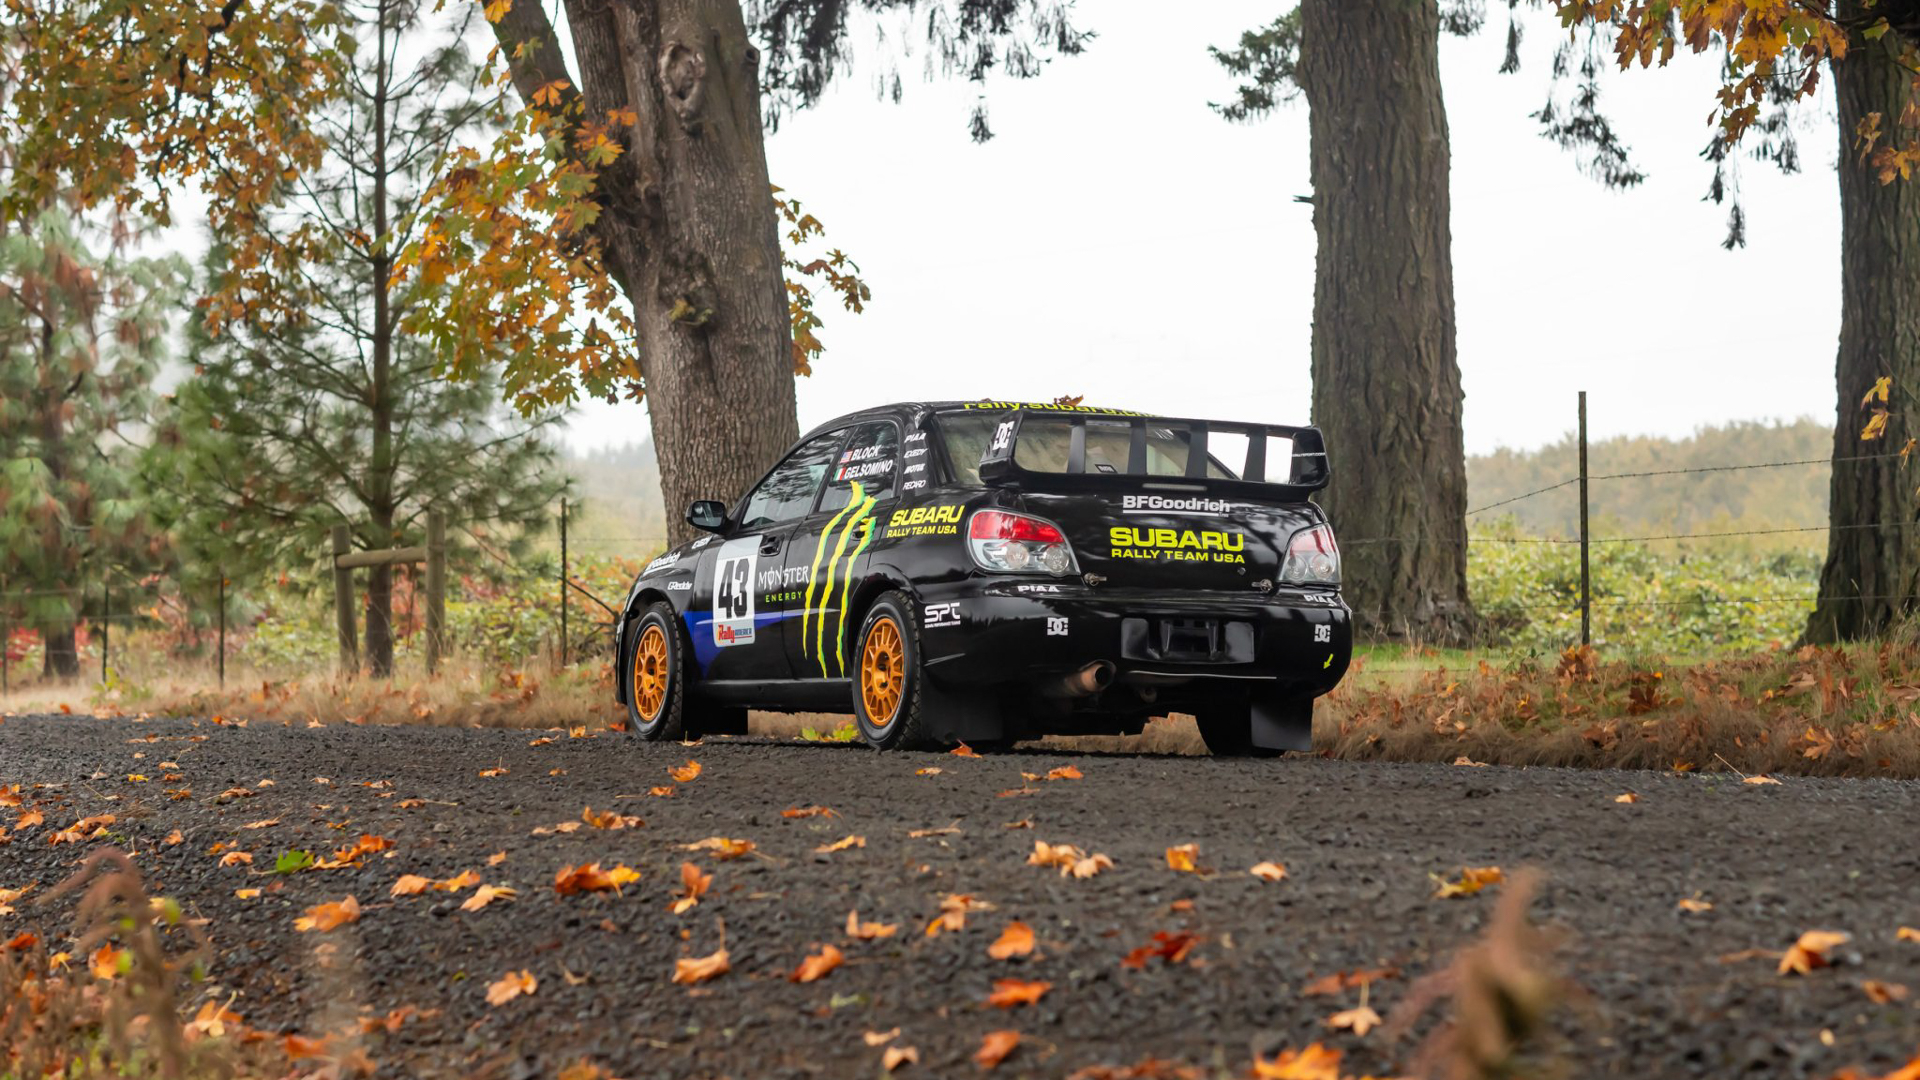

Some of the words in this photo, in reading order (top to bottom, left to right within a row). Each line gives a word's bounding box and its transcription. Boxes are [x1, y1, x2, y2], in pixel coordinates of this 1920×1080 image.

[904, 433, 927, 443] PIAA
[992, 421, 1015, 450] DC
[850, 445, 881, 460] BLOCK
[844, 460, 893, 479] GELSOMINO
[902, 480, 927, 491] RECARO
[1122, 495, 1230, 512] BFGoodrich
[889, 505, 965, 527] SUBARU
[887, 527, 911, 538] RALLY
[912, 525, 936, 535] TEAM
[937, 524, 957, 534] USA
[1110, 527, 1244, 552] SUBARU
[1111, 548, 1160, 559] RALLY
[1164, 551, 1209, 561] TEAM
[1213, 553, 1245, 564] USA
[758, 565, 809, 590] MONSTER
[718, 558, 750, 619] 43
[765, 591, 802, 603] ENERGY
[1017, 585, 1060, 593] PIAA
[1303, 594, 1338, 606] PIAA
[924, 602, 960, 623] SPT
[1047, 617, 1069, 636] DC
[1314, 624, 1331, 643] DC
